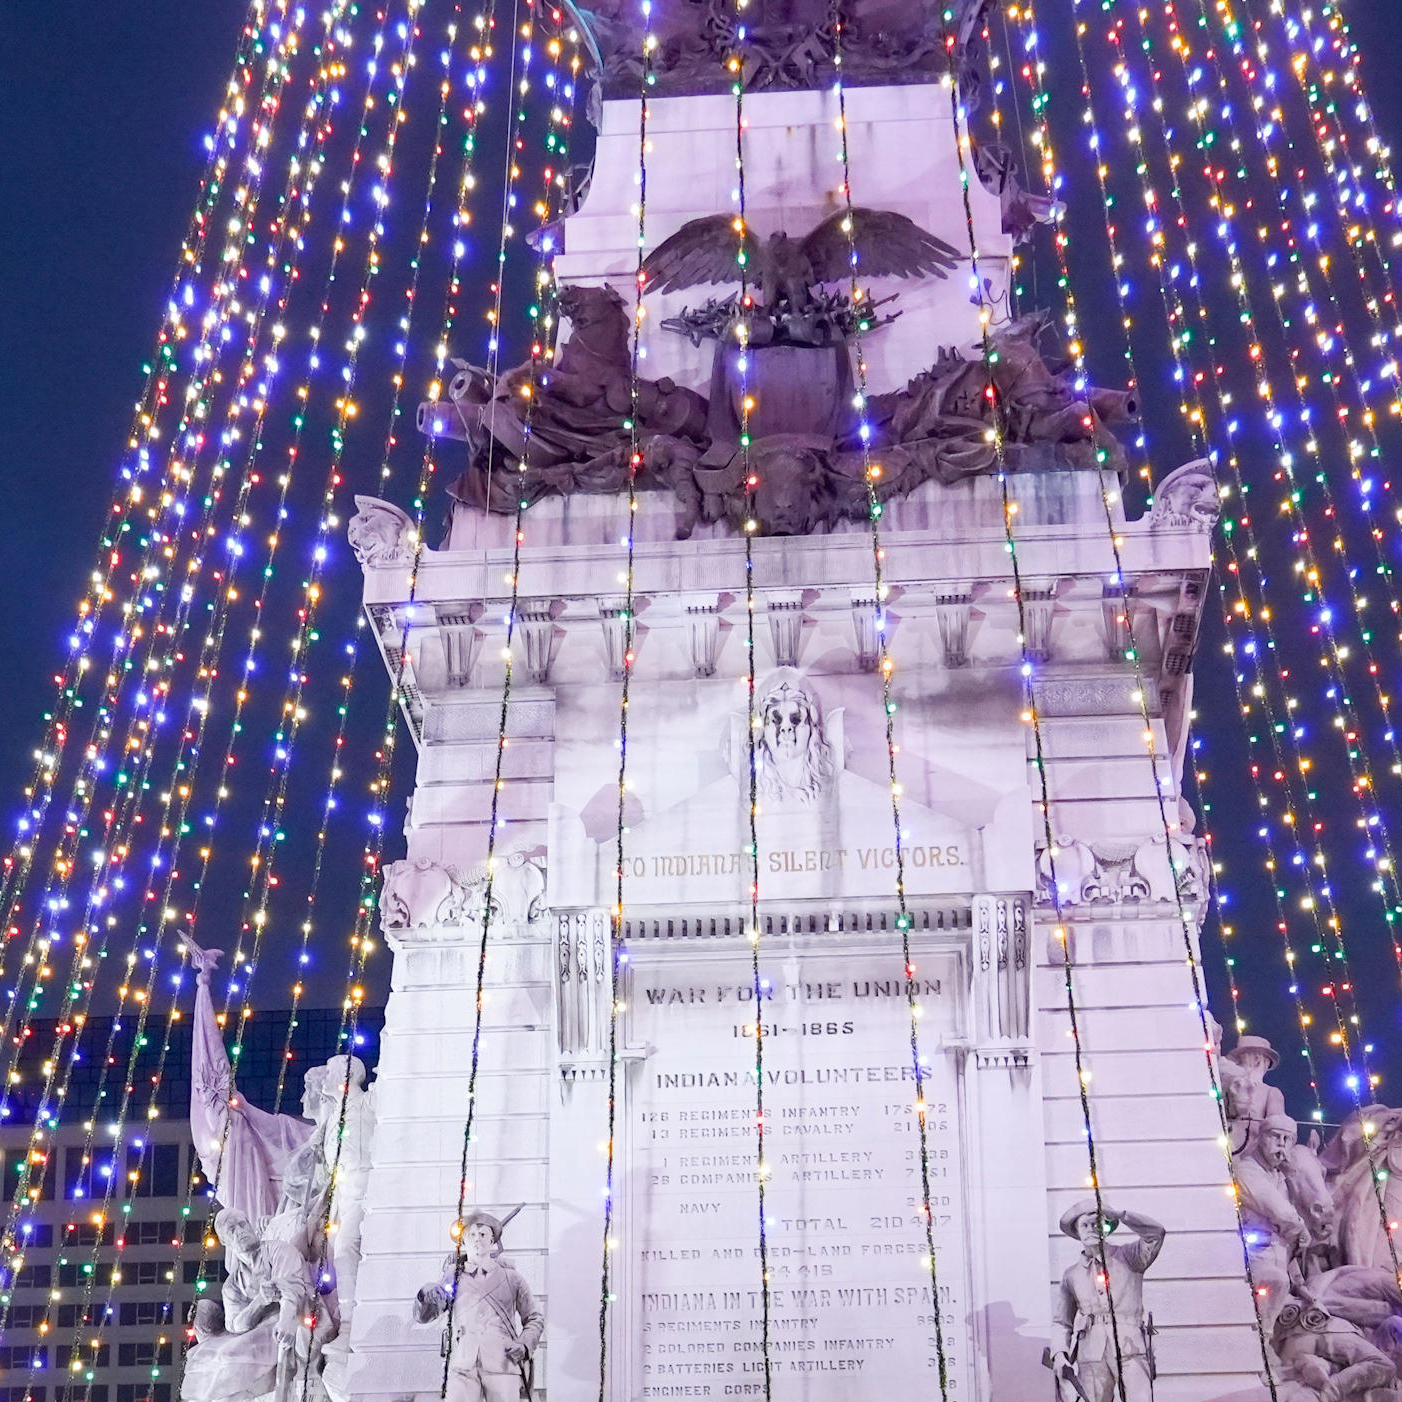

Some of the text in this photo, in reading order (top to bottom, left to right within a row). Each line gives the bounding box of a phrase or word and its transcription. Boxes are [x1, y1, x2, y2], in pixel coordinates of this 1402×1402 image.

[770, 851, 848, 873] SILENT
[646, 979, 943, 1005] WAR FOR THE UNION
[656, 1066, 933, 1089] INDIANA VOLUNTEERS
[679, 1202, 721, 1214] NAVY
[782, 1217, 848, 1231] TOTAL
[643, 1384, 769, 1397] ENGINEER CORPS
